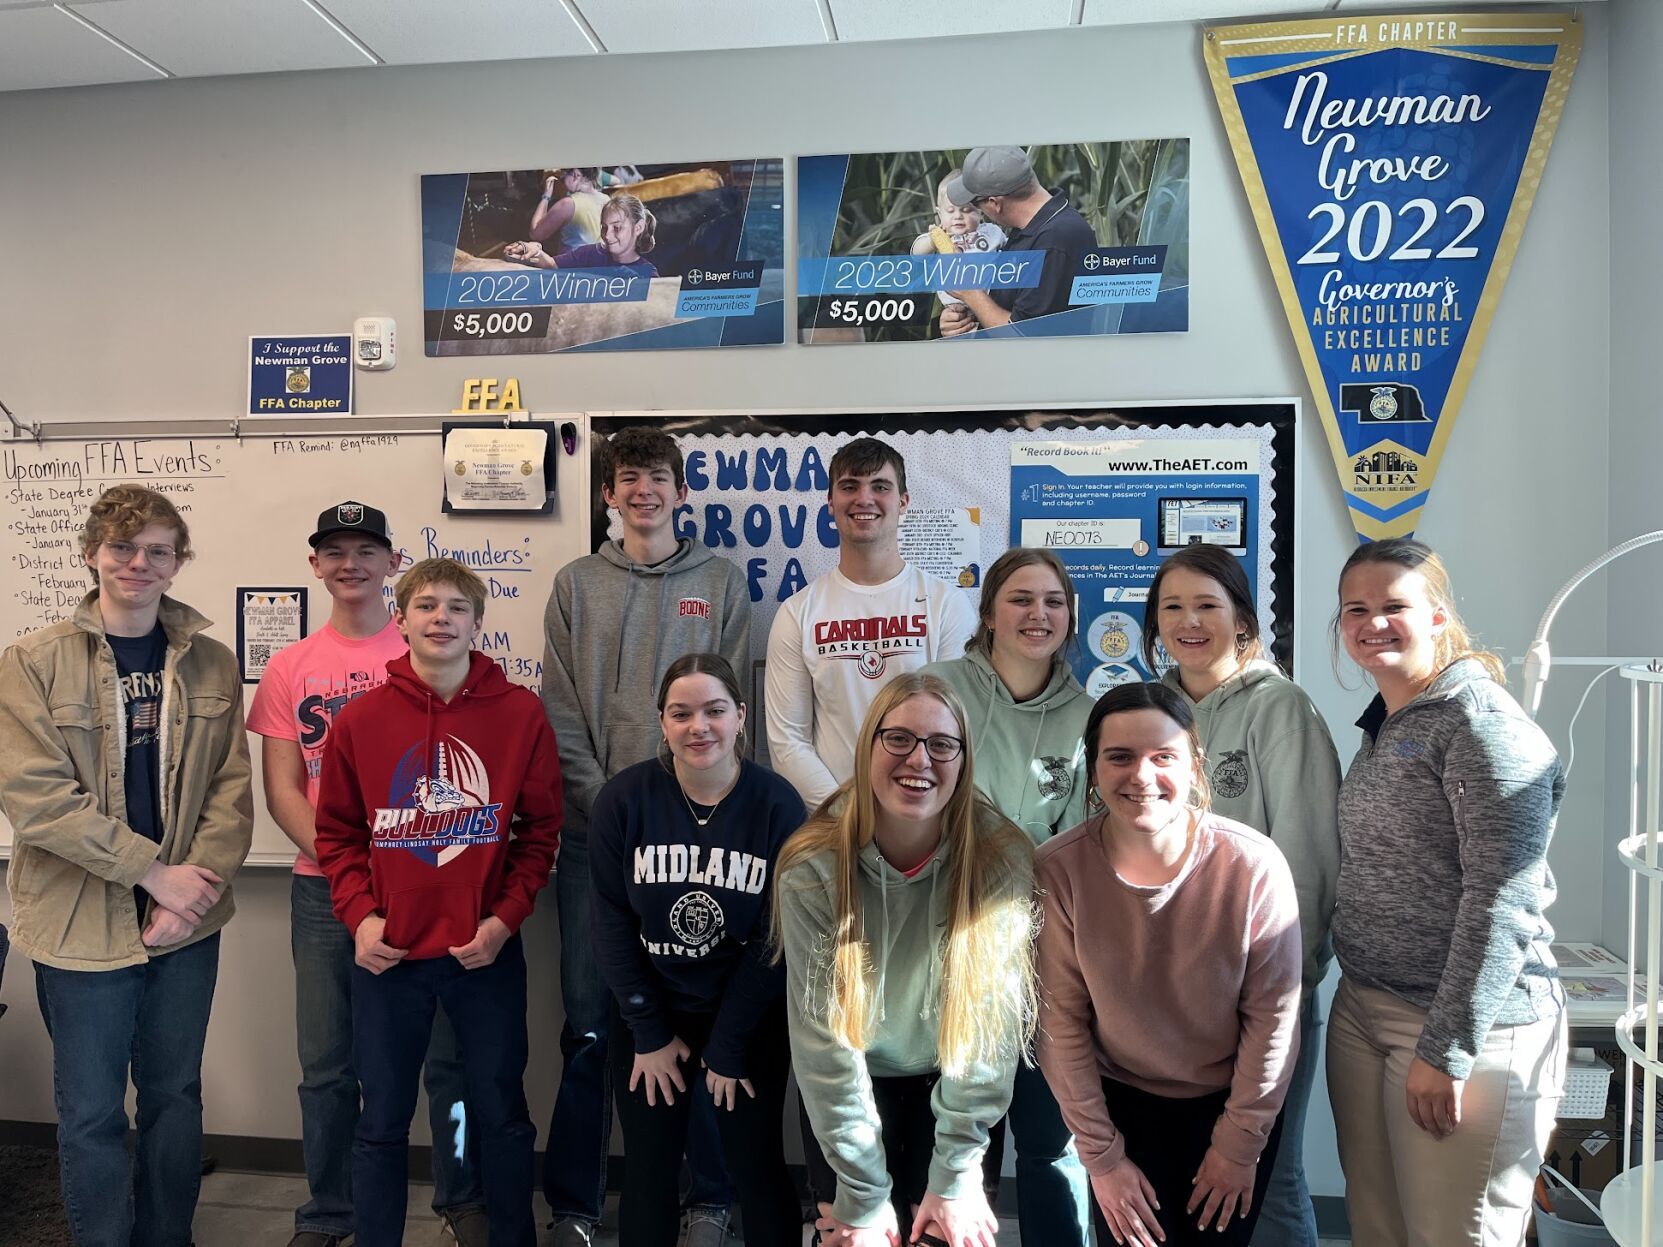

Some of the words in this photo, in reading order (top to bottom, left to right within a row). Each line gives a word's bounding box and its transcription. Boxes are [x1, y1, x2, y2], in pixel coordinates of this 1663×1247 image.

[1336, 23, 1369, 44] FFA
[1378, 20, 1458, 42] CHAPTER
[1283, 71, 1492, 146] Newman
[1318, 132, 1450, 201] Grove
[1297, 196, 1486, 265] 2022
[1102, 256, 1131, 268] Bayer
[1132, 254, 1157, 265] Fund
[705, 270, 732, 283] Bayer
[732, 269, 754, 280] Fund
[835, 260, 913, 289] 2023
[923, 258, 1030, 286] Winner
[458, 274, 530, 303] 2022
[539, 271, 639, 300] Winner
[1076, 286, 1151, 299] Communities
[1318, 269, 1460, 311] Governor's
[681, 300, 750, 312] Communities
[829, 299, 915, 326] $5,000
[1312, 302, 1463, 326] AGRICULTURAL
[453, 312, 533, 338] $5,000
[1324, 327, 1450, 350] EXCELLENCE
[262, 342, 271, 354] I
[274, 342, 321, 357] Support
[323, 341, 340, 353] the
[255, 356, 308, 366] Newman
[312, 355, 348, 365] Grove
[1351, 352, 1422, 373] AWARD
[462, 377, 522, 411] FFA
[259, 398, 285, 409] FFA
[289, 397, 342, 411] Chapter
[273, 441, 295, 454] FFA
[299, 441, 334, 453] Remind:
[1063, 447, 1089, 456] Book
[4, 449, 82, 491] Upcoming
[85, 441, 127, 474] FFA
[134, 440, 221, 474] Events:
[1108, 458, 1248, 472] www.TheAET.com
[1042, 483, 1057, 492] Sign
[1114, 482, 1126, 490] will
[1126, 482, 1154, 491] provide
[1154, 483, 1168, 491] you
[1185, 482, 1203, 491] login
[1355, 474, 1416, 485] NIFA
[10, 488, 43, 504] State
[48, 487, 94, 505] Degree
[1042, 492, 1073, 500] including
[1112, 492, 1147, 500] password
[1056, 500, 1085, 508] chapter
[15, 521, 47, 536] State
[672, 503, 841, 549] GROVE
[1068, 520, 1090, 528] chapter
[19, 553, 63, 570] District
[1108, 563, 1134, 571] Record
[488, 577, 520, 599] Due
[20, 590, 51, 607] State
[679, 599, 711, 620] BOONE
[815, 615, 927, 645] CARDINALS
[818, 638, 923, 655] BASKETBALL
[372, 803, 503, 840] BULLDOGS
[634, 844, 767, 895] MIDLAND
